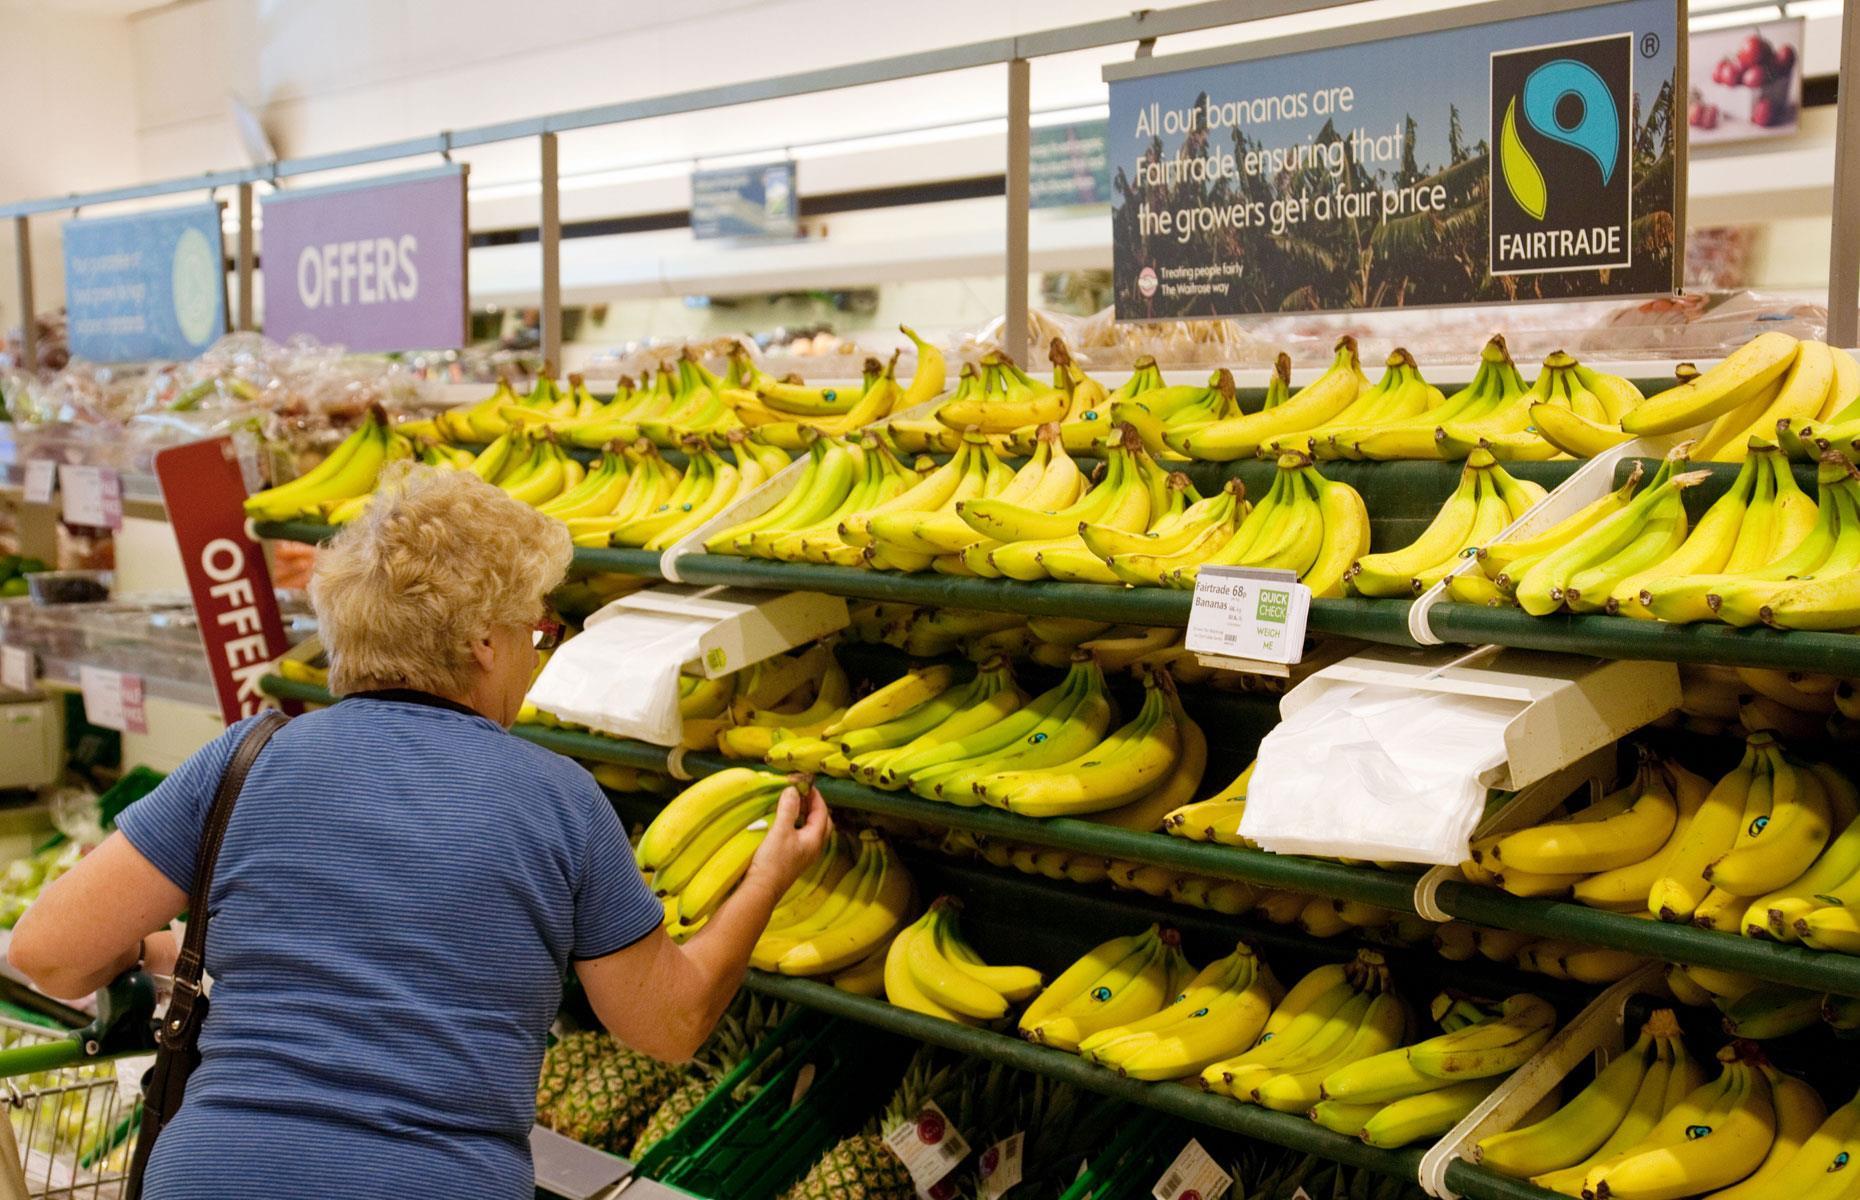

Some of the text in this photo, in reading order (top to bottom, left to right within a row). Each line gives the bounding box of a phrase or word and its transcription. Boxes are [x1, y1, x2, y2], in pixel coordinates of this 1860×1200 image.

[1135, 86, 1354, 138] All our bananas are
[1136, 145, 1240, 188] Fairtrade,
[1244, 134, 1344, 177] ensuring
[1350, 123, 1403, 164] that
[1137, 177, 1447, 243] the growers get a fair price
[1500, 226, 1621, 261] FAIRTRADE
[297, 234, 418, 310] OFFERS
[1161, 262, 1244, 281] Treating people fairly
[1162, 282, 1230, 296] The Waitrose way
[1196, 582, 1230, 596] Fairtrade
[1195, 597, 1228, 610] Bananas
[1261, 592, 1287, 606] QUICK
[1260, 605, 1286, 618] CHECK
[1256, 627, 1280, 638] WEIGH
[1263, 641, 1274, 650] ME
